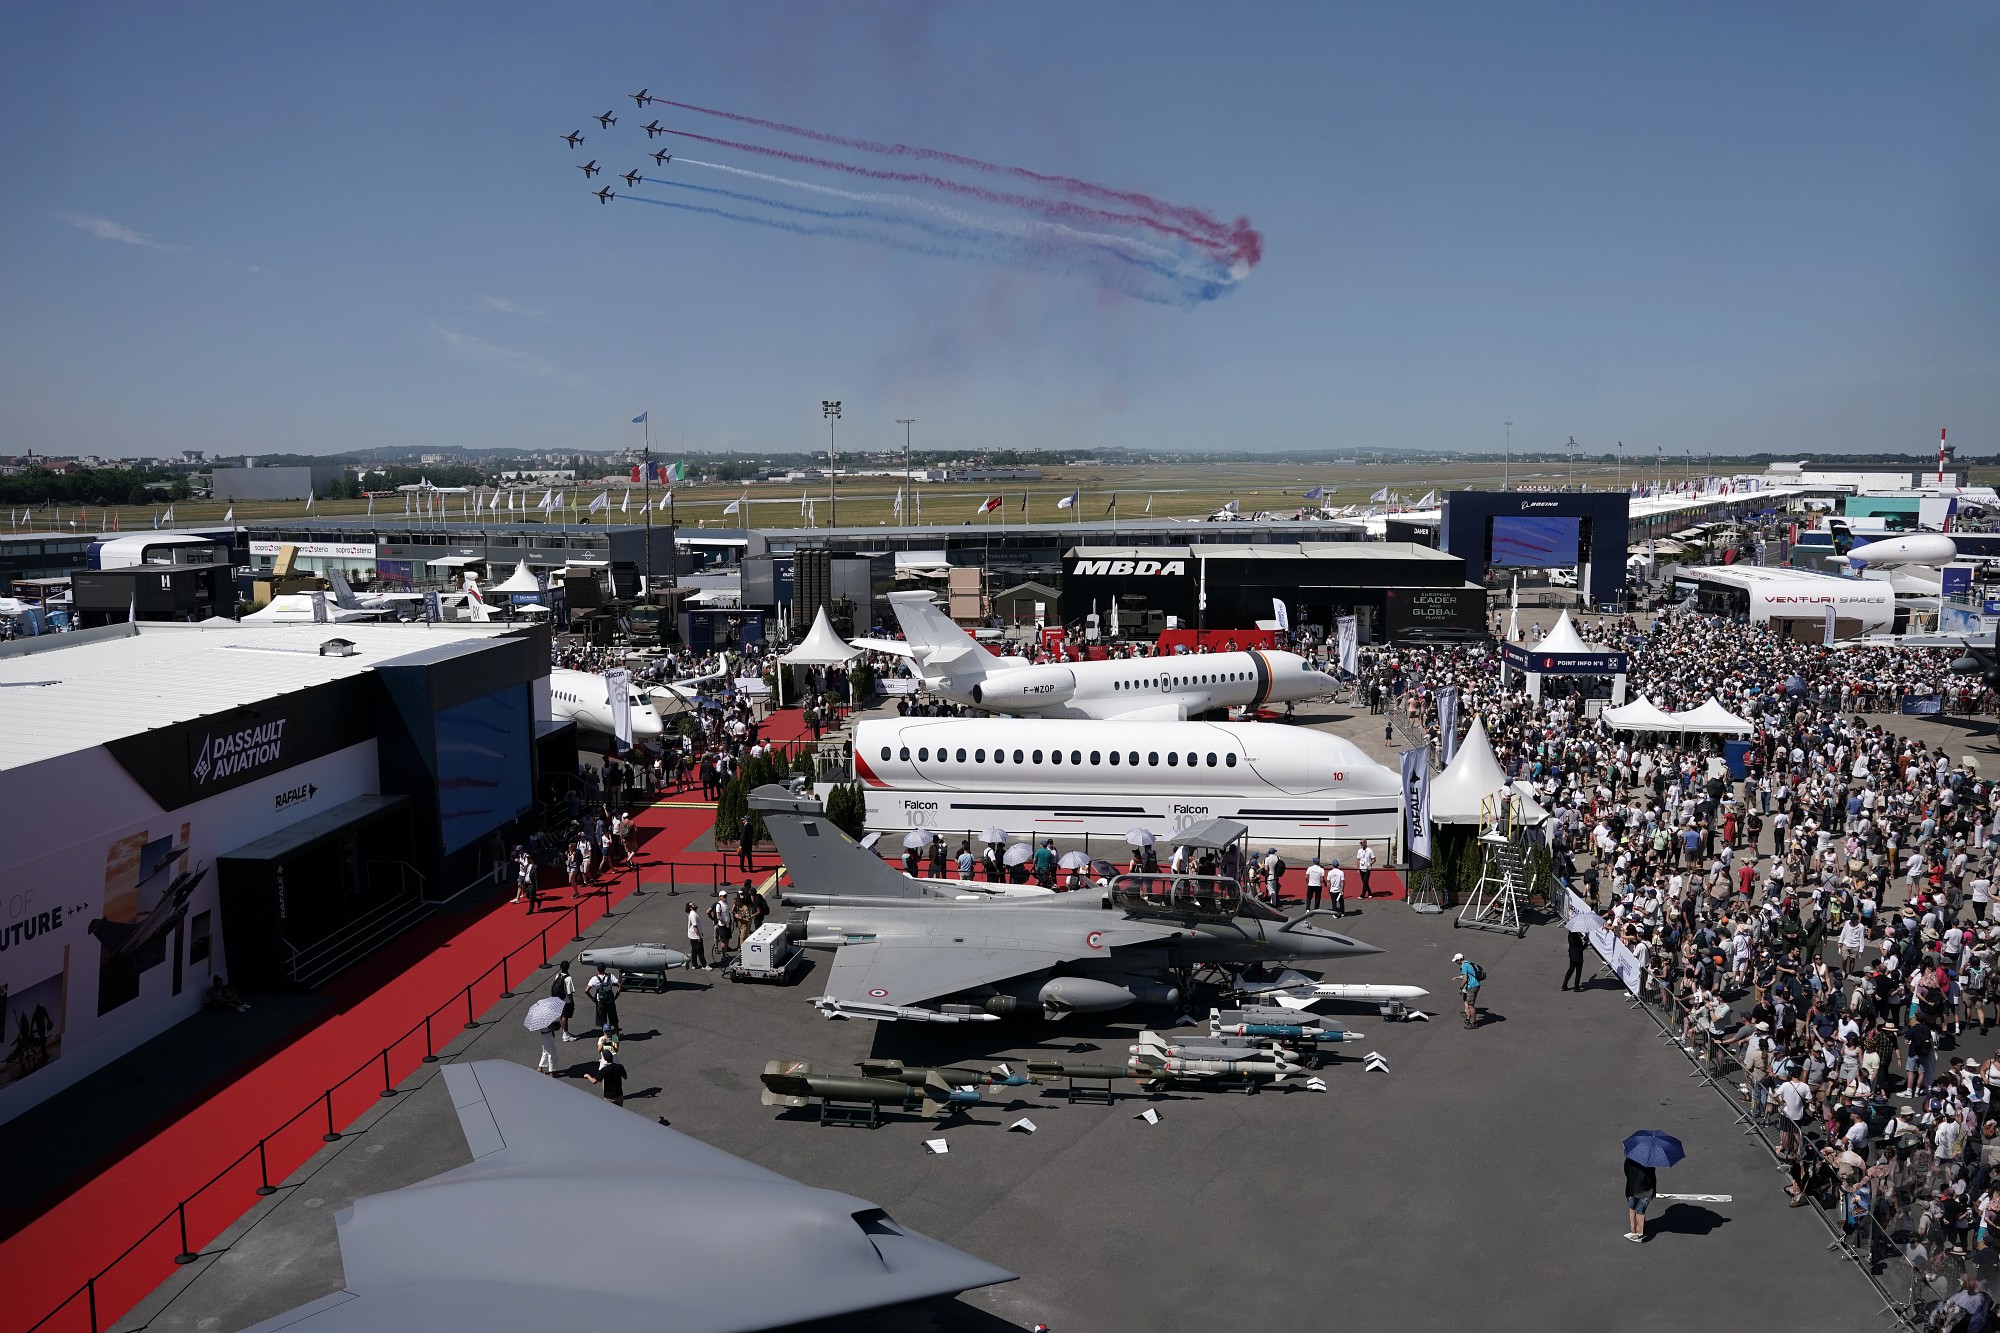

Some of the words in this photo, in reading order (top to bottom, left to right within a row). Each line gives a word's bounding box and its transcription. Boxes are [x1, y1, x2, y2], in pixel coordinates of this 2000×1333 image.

[1414, 527, 1428, 535] DAHER
[1073, 561, 1185, 575] MBDA
[1689, 571, 1709, 579] VENTURI
[1023, 684, 1055, 694] F-WZOP
[213, 719, 286, 759] DASSAULT
[212, 741, 281, 781] AVIATION
[275, 785, 308, 809] RAFALE
[904, 800, 938, 810] Falcon
[1173, 804, 1209, 814] Falcon
[1410, 787, 1423, 838] RAFALE
[905, 810, 938, 827] 10X
[9, 889, 35, 918] OF
